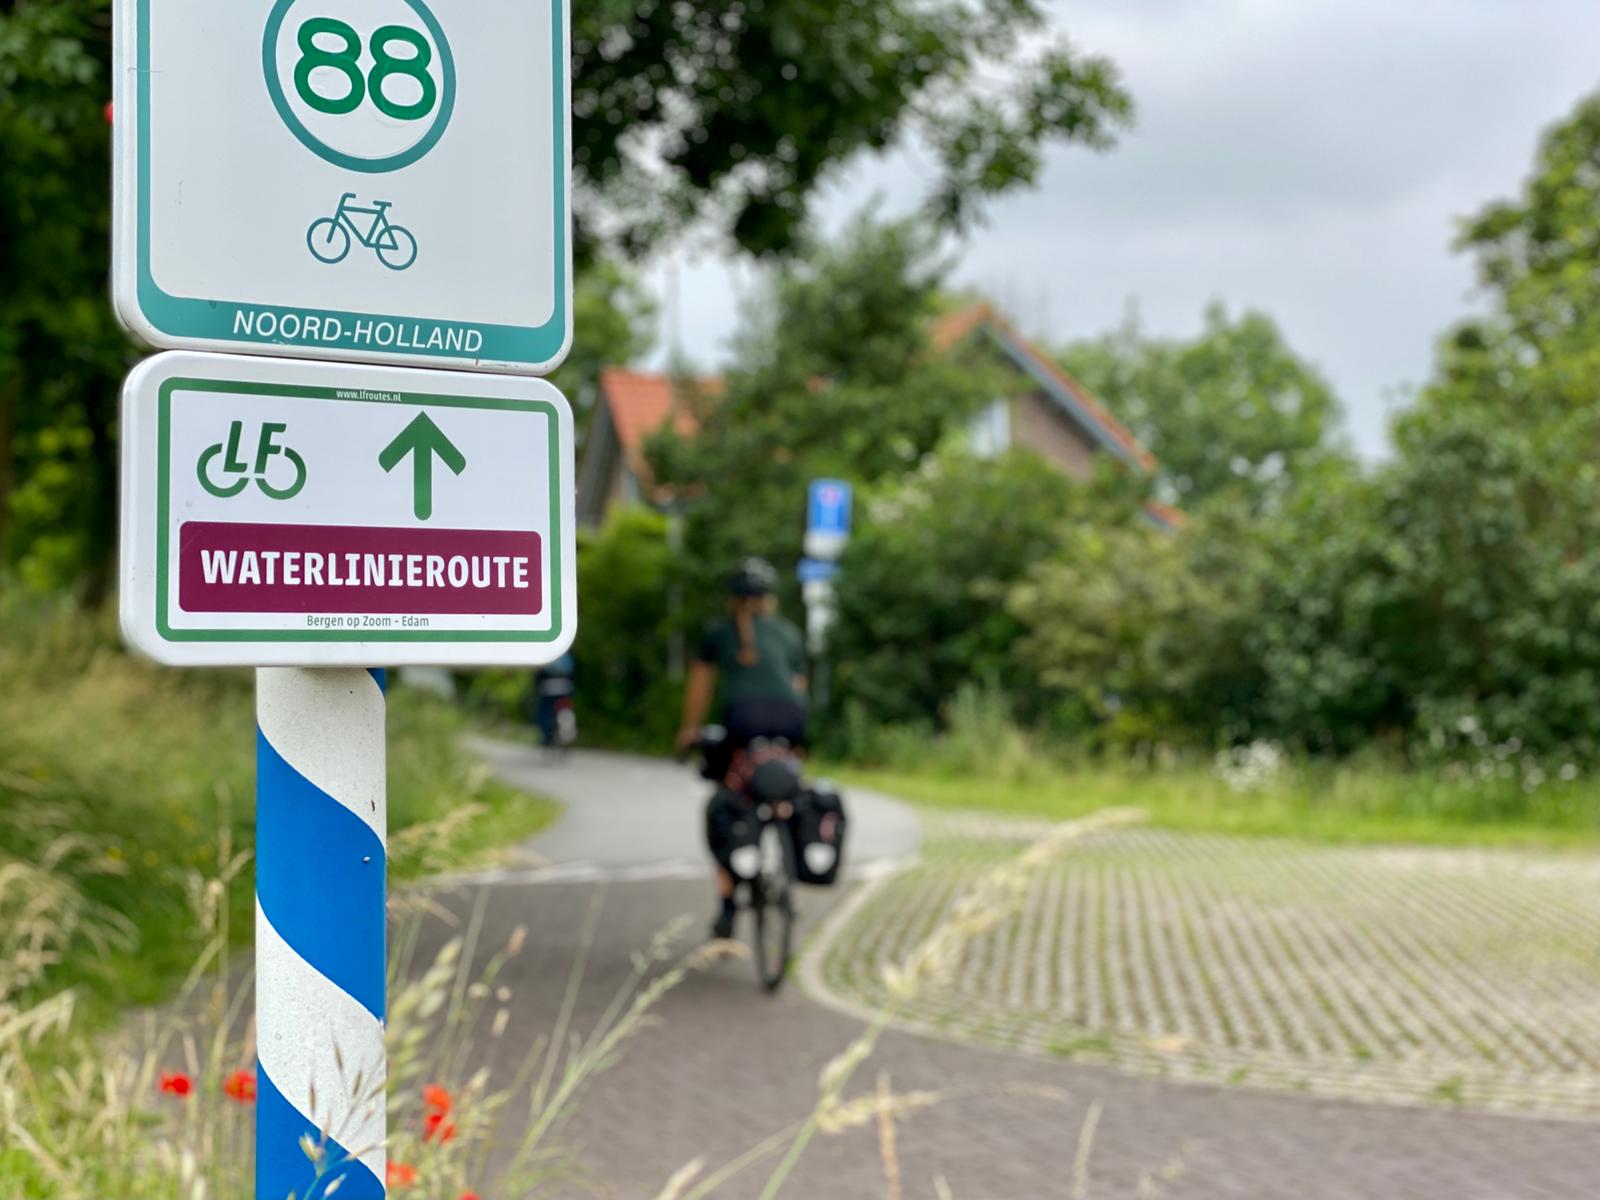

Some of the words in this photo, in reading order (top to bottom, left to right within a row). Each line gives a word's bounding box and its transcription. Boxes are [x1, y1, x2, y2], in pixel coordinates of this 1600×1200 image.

[294, 17, 437, 120] 88
[233, 310, 483, 353] NOORD-HOLLAND
[336, 390, 402, 402] www.lfroutes.nl
[223, 420, 287, 474] LF
[201, 549, 529, 588] WATERLINIEROUTE
[307, 615, 344, 628] Bergen
[346, 617, 360, 627] op
[362, 616, 391, 626] Zoom
[401, 616, 430, 626] Edam
